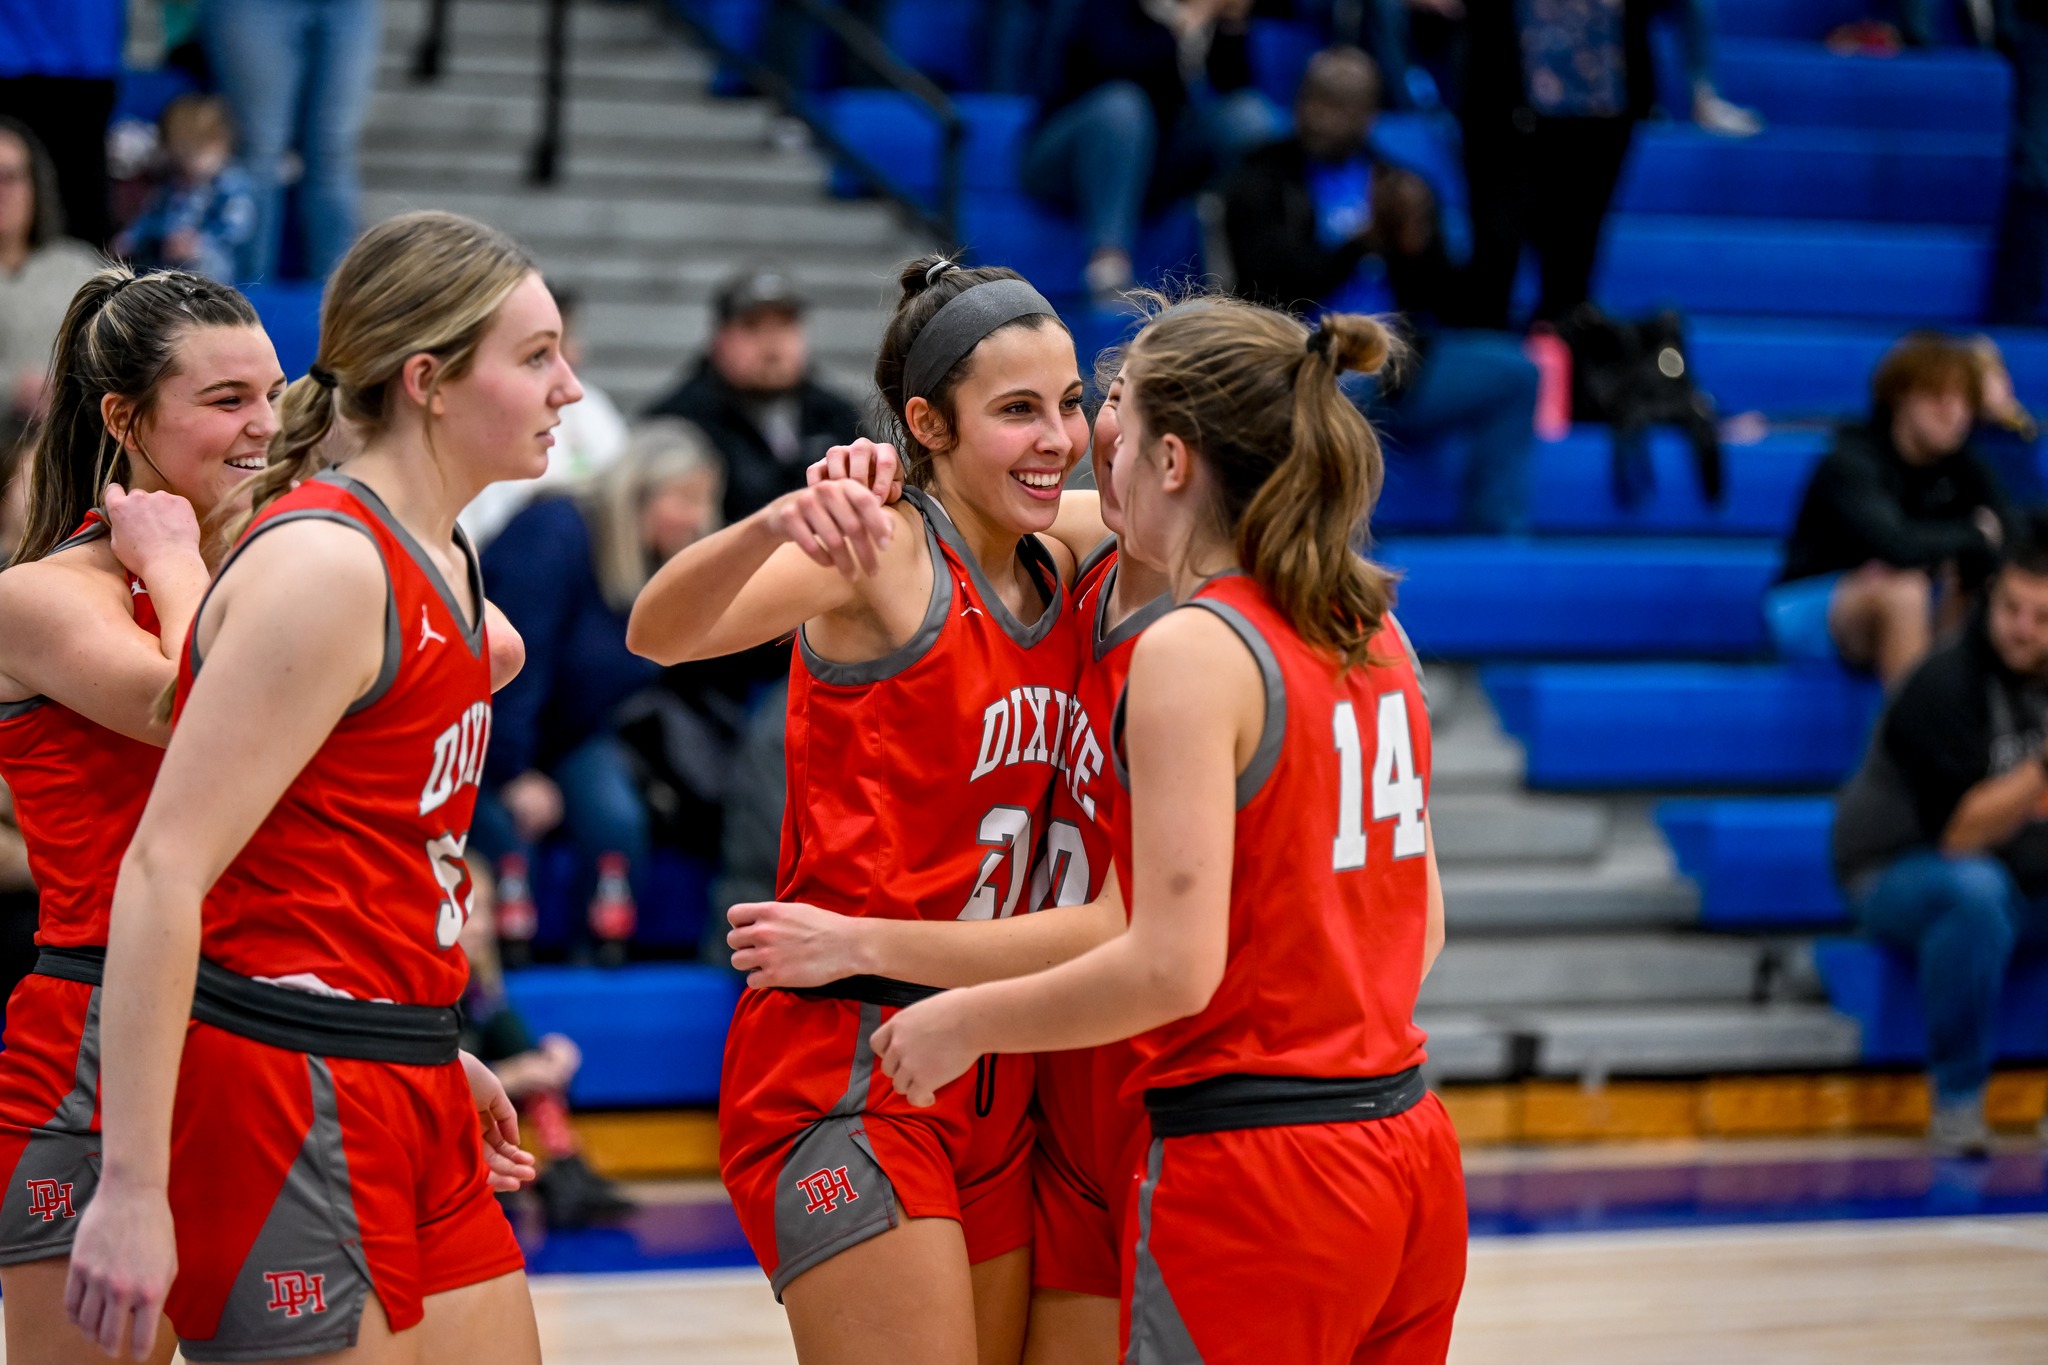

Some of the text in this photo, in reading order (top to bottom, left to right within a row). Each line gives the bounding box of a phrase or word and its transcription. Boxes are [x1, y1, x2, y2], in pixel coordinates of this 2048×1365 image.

[418, 700, 492, 816] DIXI
[1332, 689, 1426, 873] 14
[26, 1178, 77, 1222] DH
[796, 1165, 859, 1214] DH
[263, 1270, 328, 1318] DH
